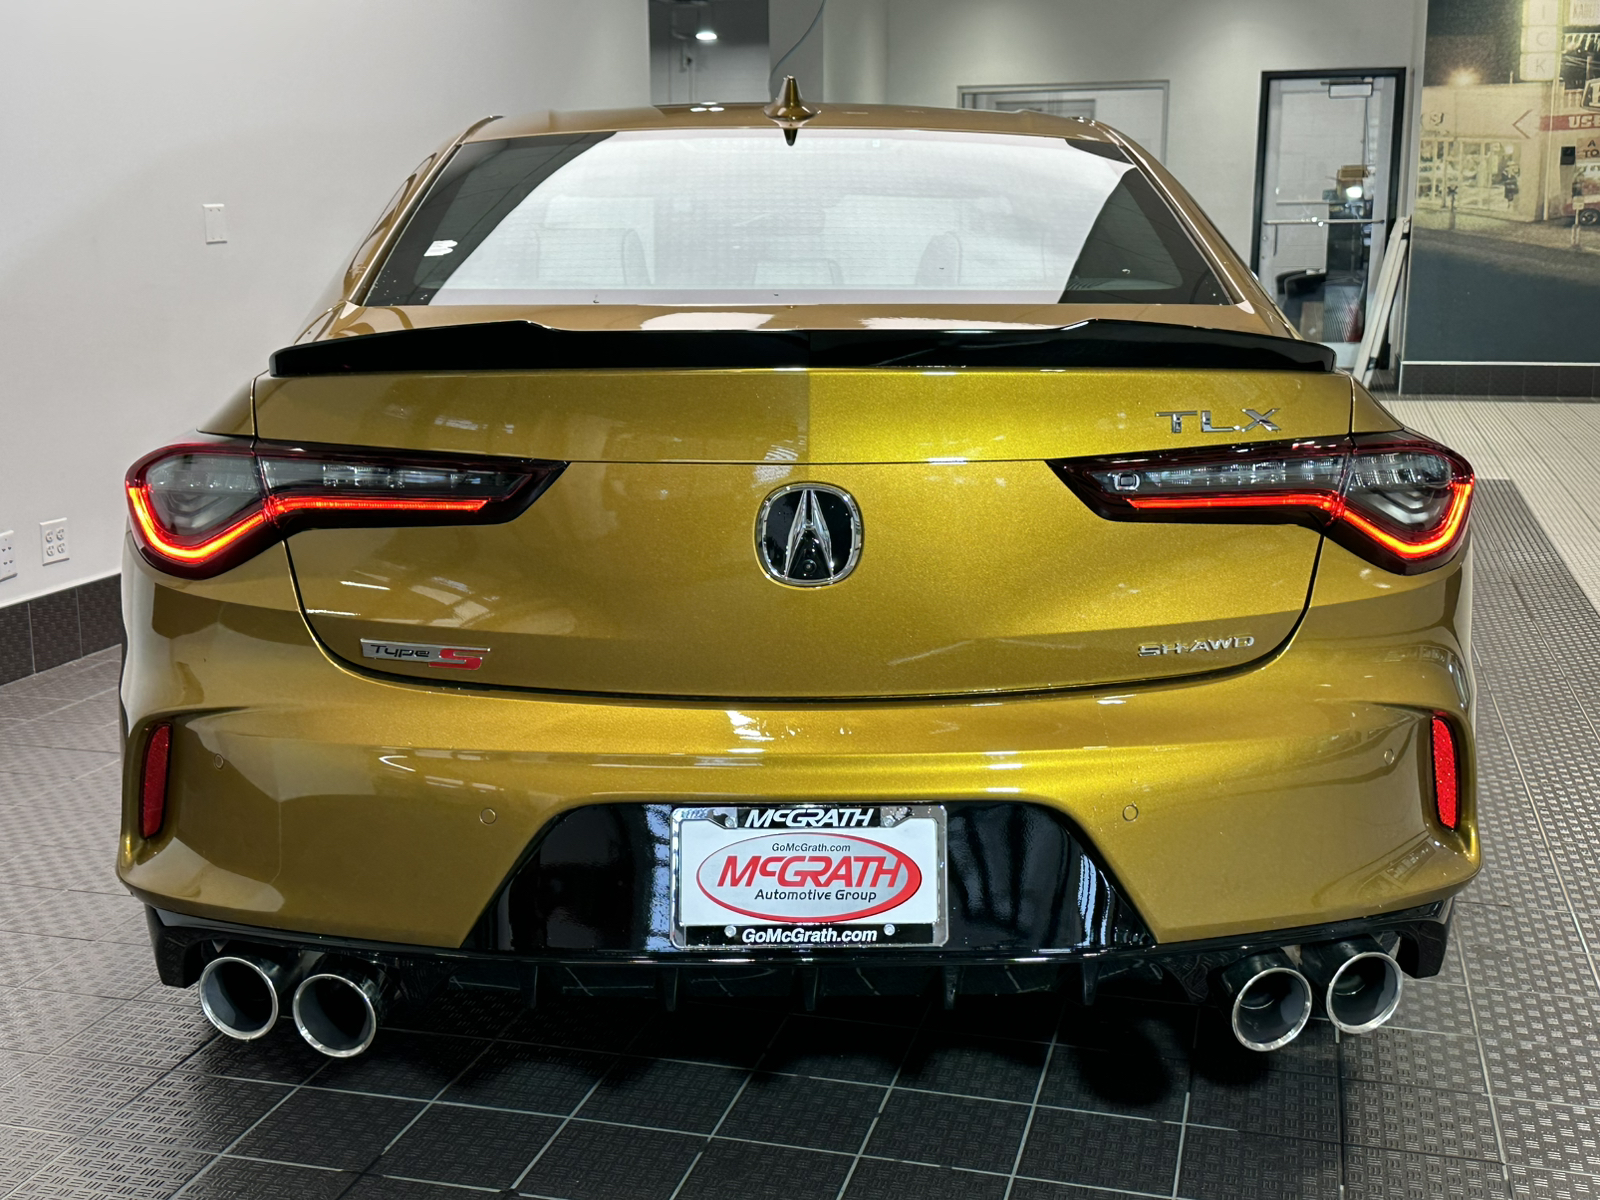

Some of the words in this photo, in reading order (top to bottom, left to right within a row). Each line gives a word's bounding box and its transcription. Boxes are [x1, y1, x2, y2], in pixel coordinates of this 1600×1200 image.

[1155, 408, 1281, 434] TLX
[370, 644, 430, 658] Type
[428, 647, 490, 671] S
[771, 842, 851, 853] GoMcGrath.com
[754, 888, 831, 901] Automotive
[835, 889, 877, 903] Group
[741, 928, 878, 944] GoMcGrath.com
